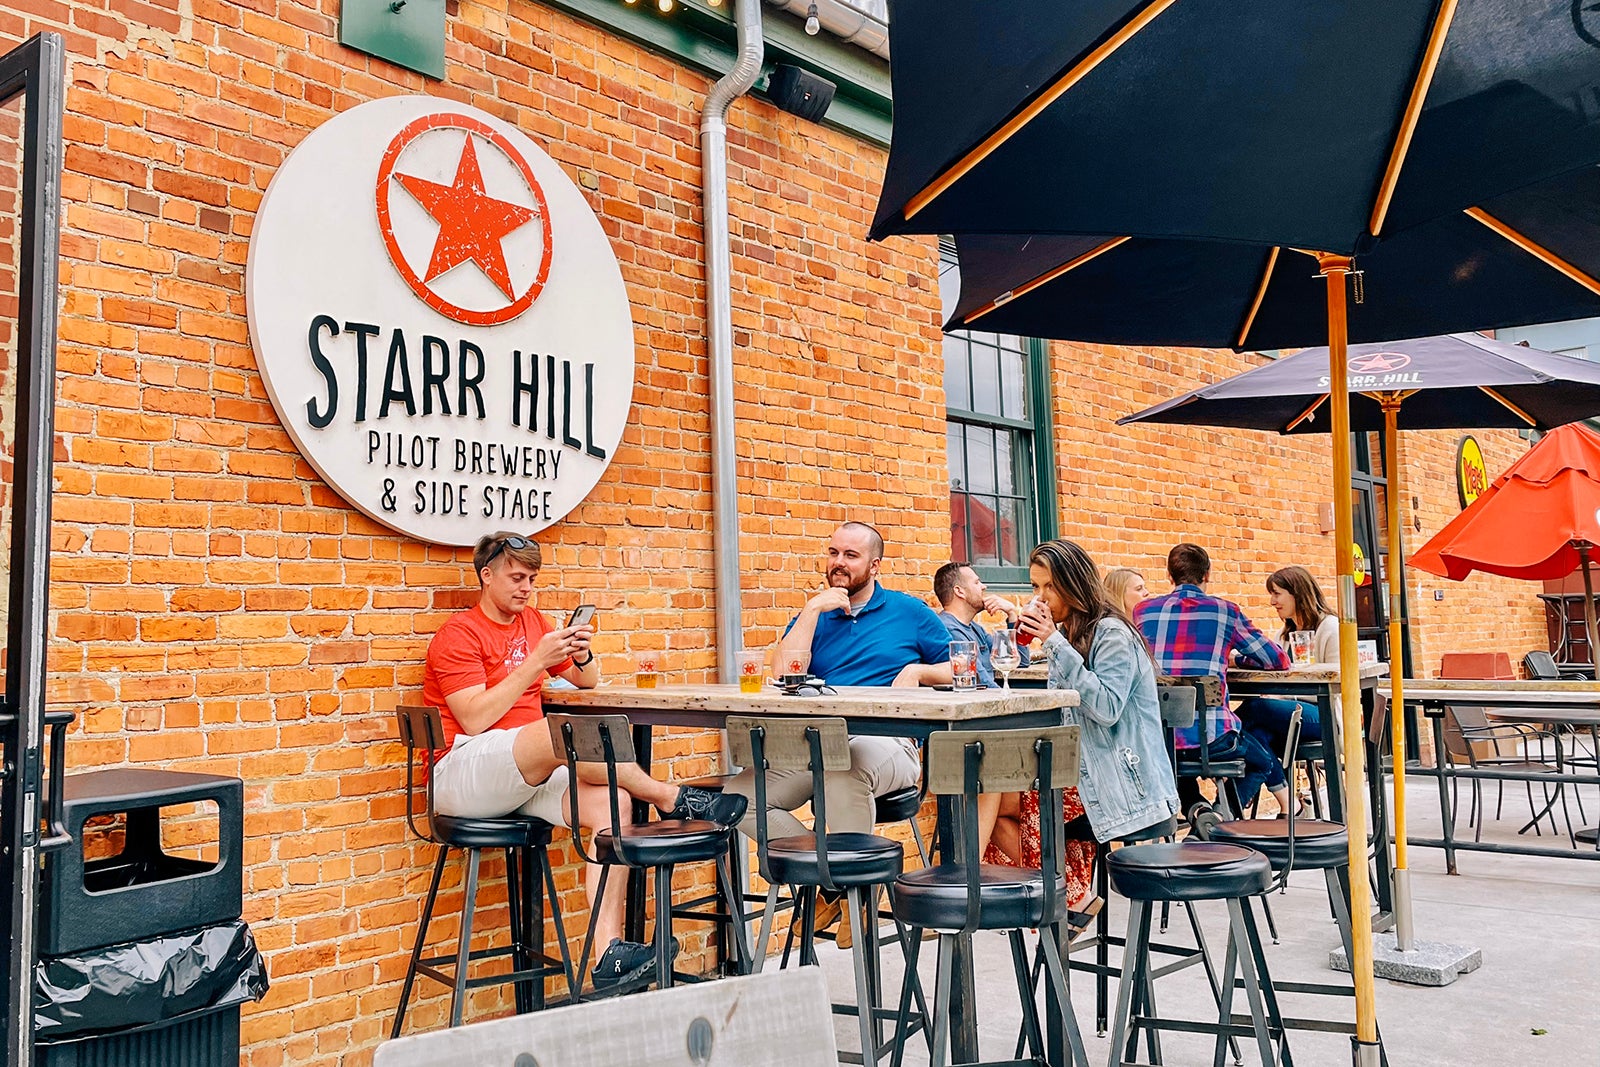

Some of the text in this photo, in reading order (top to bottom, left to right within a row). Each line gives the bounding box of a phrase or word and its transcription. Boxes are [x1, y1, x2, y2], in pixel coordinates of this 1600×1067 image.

[307, 315, 606, 460] STARR HILL
[1383, 372, 1424, 384] HILL
[368, 431, 562, 481] PILOT BREWERY
[381, 478, 552, 521] & SIDE STAGE
